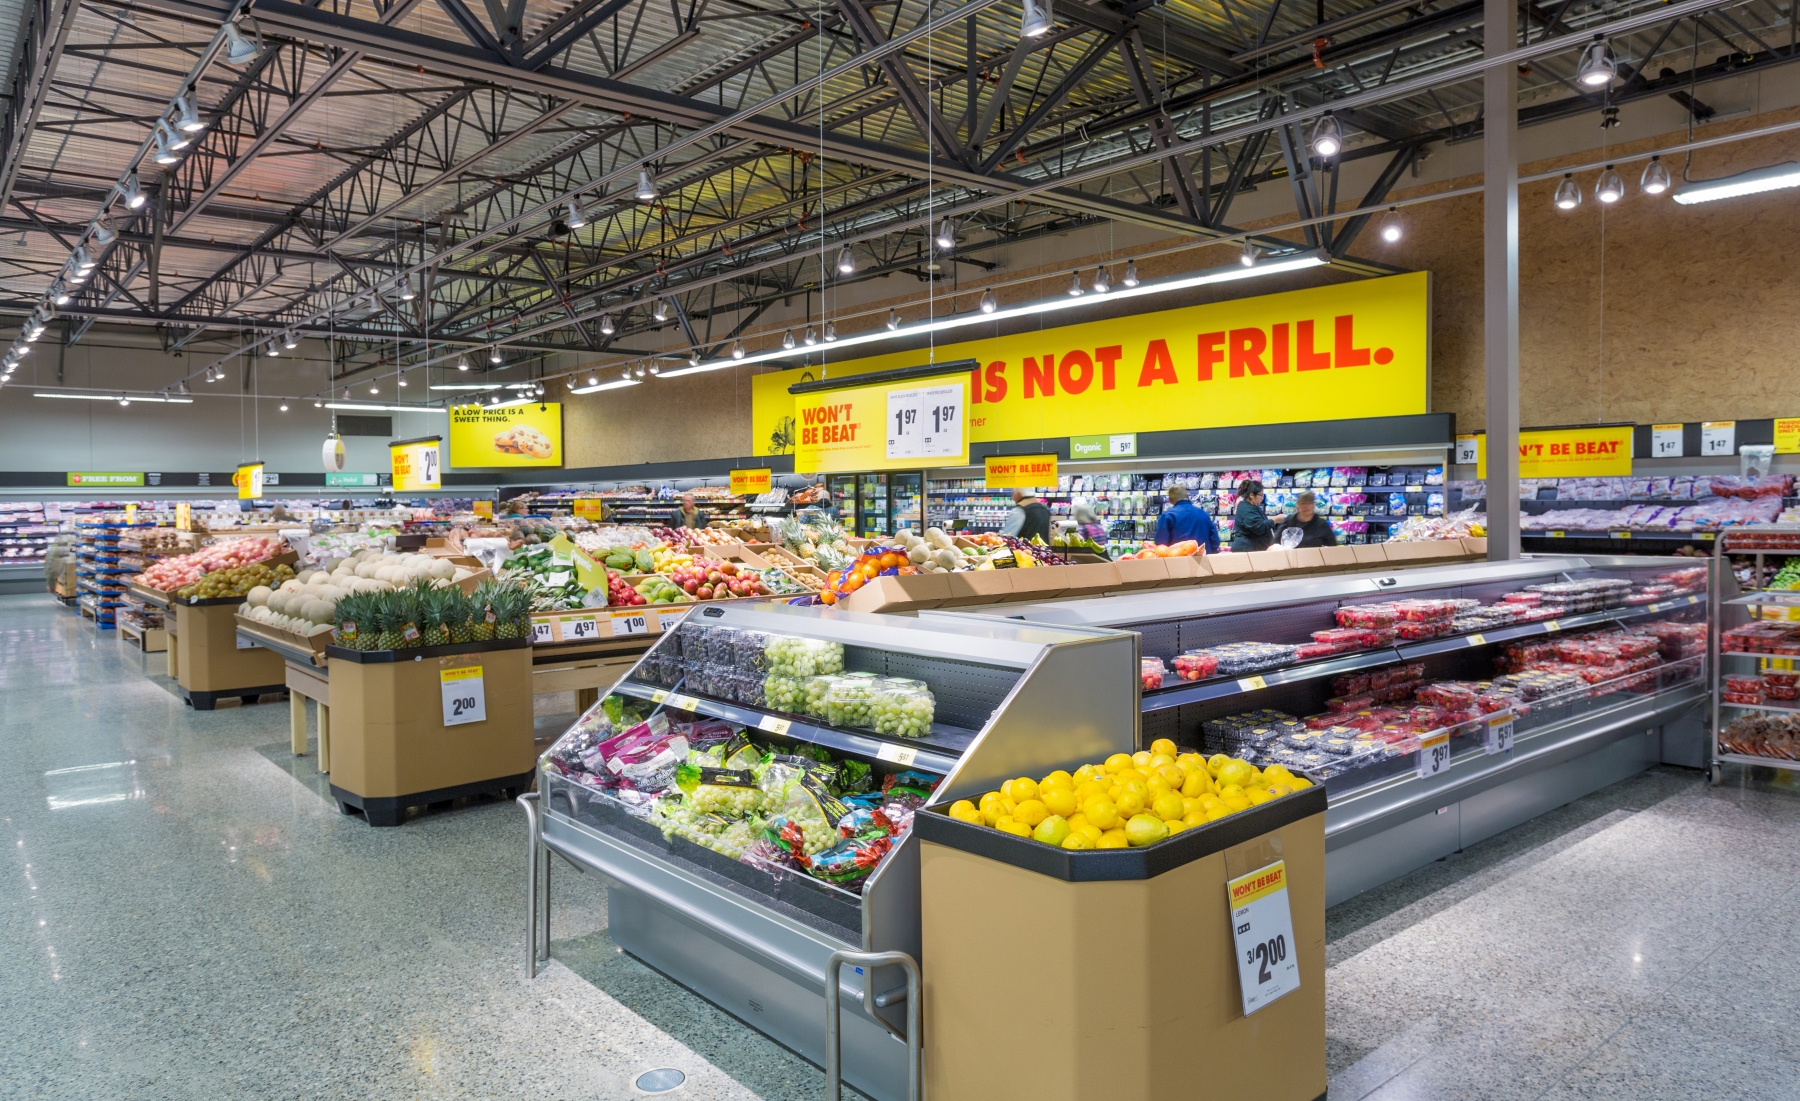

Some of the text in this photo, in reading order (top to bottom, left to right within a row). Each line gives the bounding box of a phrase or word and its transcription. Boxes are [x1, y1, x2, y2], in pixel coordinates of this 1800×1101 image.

[971, 314, 1395, 404] IS NOT A FRILL.
[483, 408, 506, 416] PRICE
[802, 403, 853, 425] WON'T
[802, 427, 818, 445] BE
[1074, 441, 1102, 453] Organic
[1550, 443, 1570, 455] BE
[1461, 450, 1474, 460] .97
[989, 464, 1017, 474] WON'T
[1020, 464, 1029, 473] BE
[571, 549, 592, 572] Organic
[1232, 880, 1256, 898] WON'T
[1256, 876, 1266, 888] BE
[1235, 907, 1250, 918] LEMON
